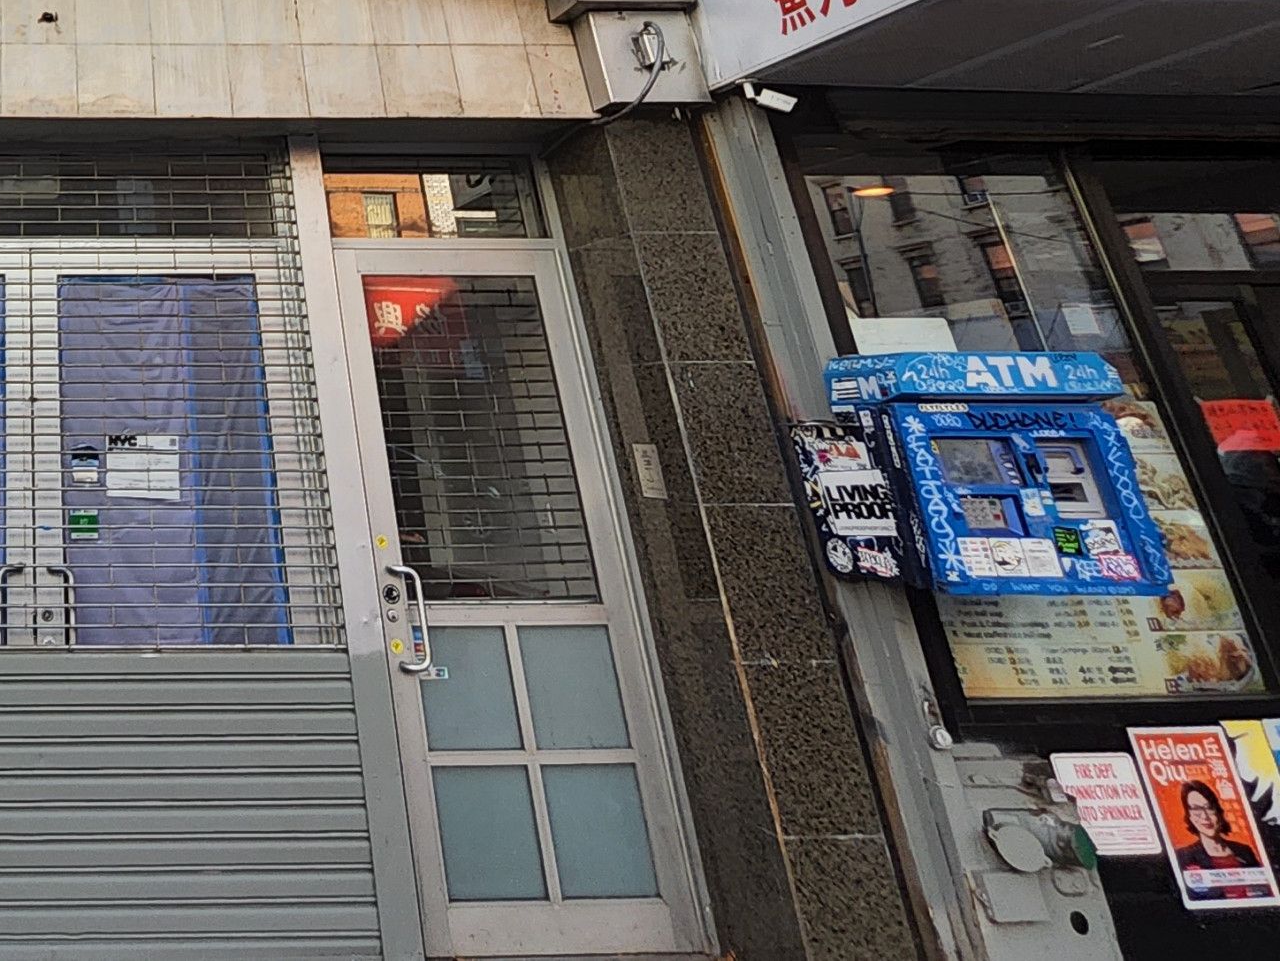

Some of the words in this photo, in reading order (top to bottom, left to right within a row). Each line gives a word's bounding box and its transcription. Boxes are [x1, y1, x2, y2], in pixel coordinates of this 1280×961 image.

[918, 362, 951, 380] 24h
[966, 355, 1059, 388] ATM
[1064, 363, 1098, 380] 24h
[108, 434, 138, 447] NYC
[825, 483, 889, 503] LIVING
[831, 502, 897, 520] PROOF
[1140, 738, 1204, 761] Helen
[1073, 763, 1094, 779] FIRE
[1149, 760, 1188, 786] Qiu
[1120, 784, 1140, 799] FOR
[1097, 804, 1144, 821] SPRINKLER
